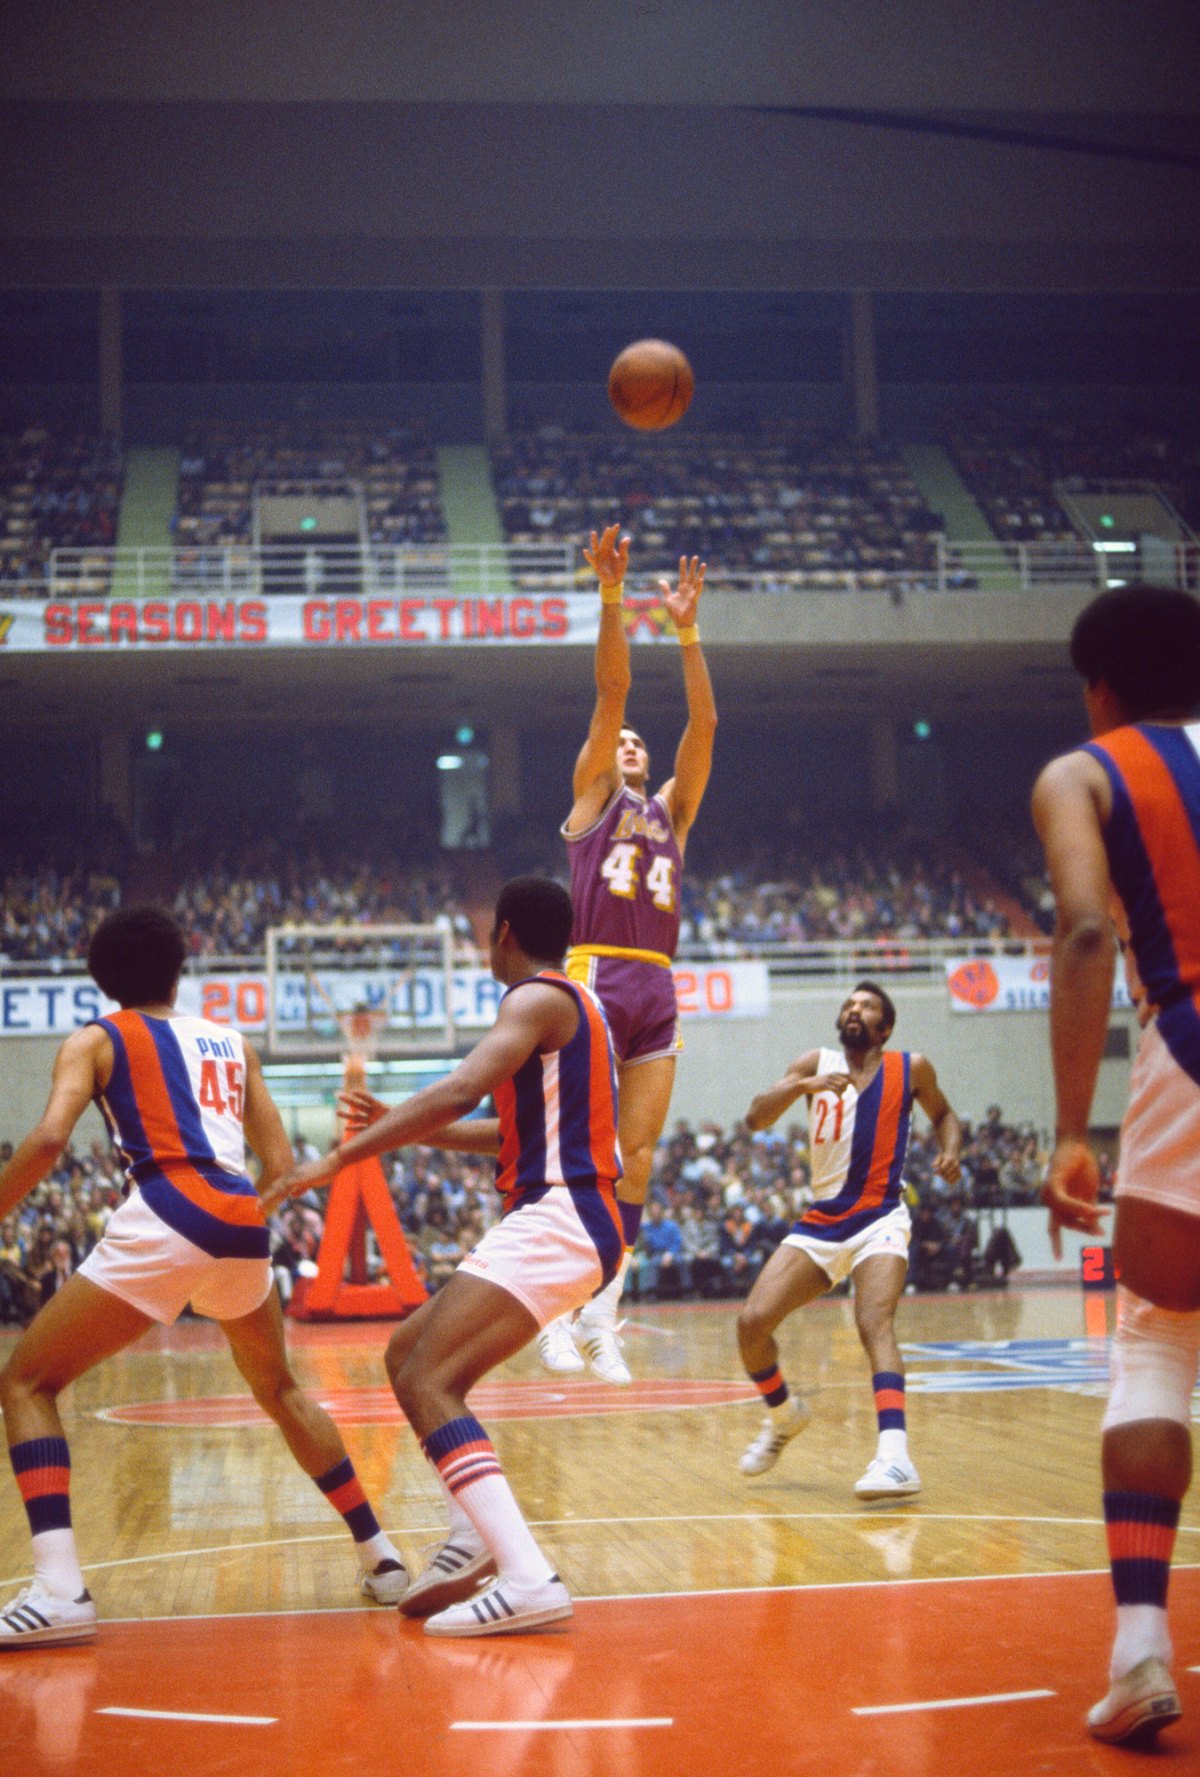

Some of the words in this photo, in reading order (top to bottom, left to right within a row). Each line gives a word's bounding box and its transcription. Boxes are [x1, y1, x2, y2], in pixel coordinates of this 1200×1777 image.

[44, 602, 267, 645] SEASONS
[302, 599, 570, 641] GREETINGS
[600, 842, 676, 914] 44
[202, 982, 267, 1025] 20
[196, 1037, 235, 1058] Phil
[199, 1060, 243, 1123] 45
[815, 1098, 845, 1145] 21
